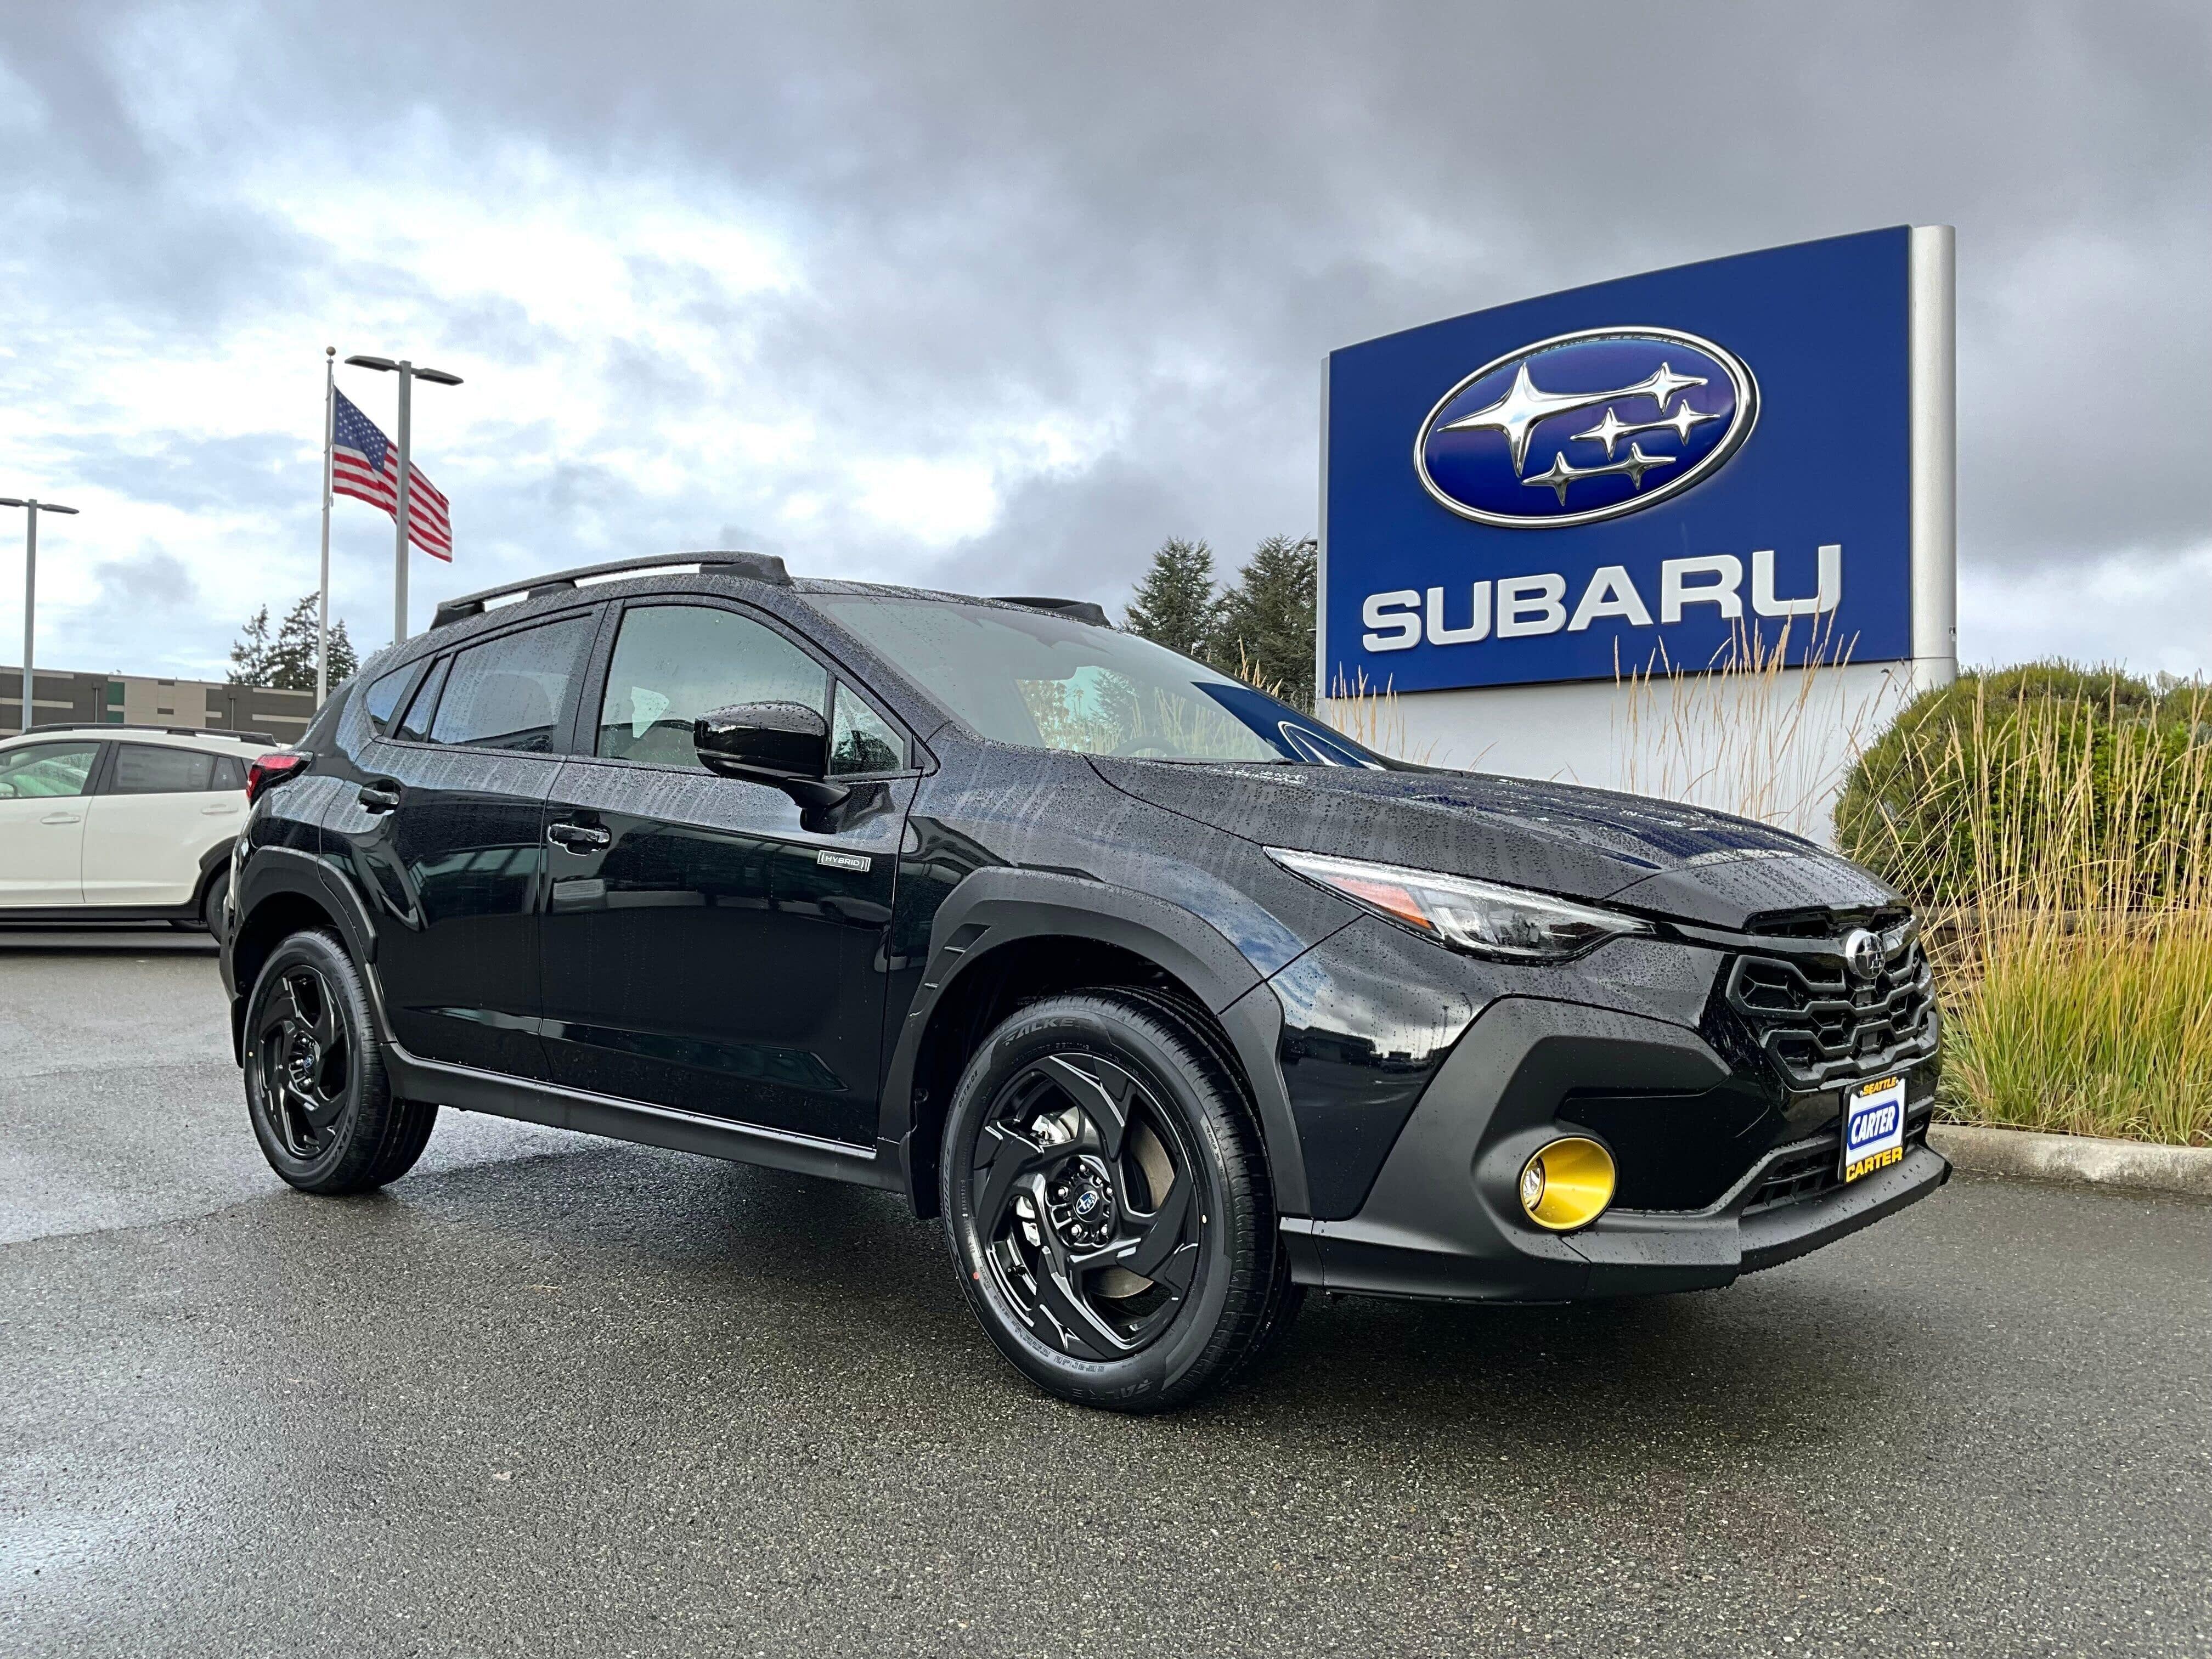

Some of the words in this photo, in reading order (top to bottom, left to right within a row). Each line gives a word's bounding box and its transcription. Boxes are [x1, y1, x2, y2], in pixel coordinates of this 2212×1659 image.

[1362, 544, 1842, 653] SUBARU
[825, 855, 860, 866] HYBRID
[1863, 1076, 1898, 1096] SEATTLE
[1851, 1105, 1895, 1144] CARTER
[1846, 1146, 1903, 1183] CARTER
